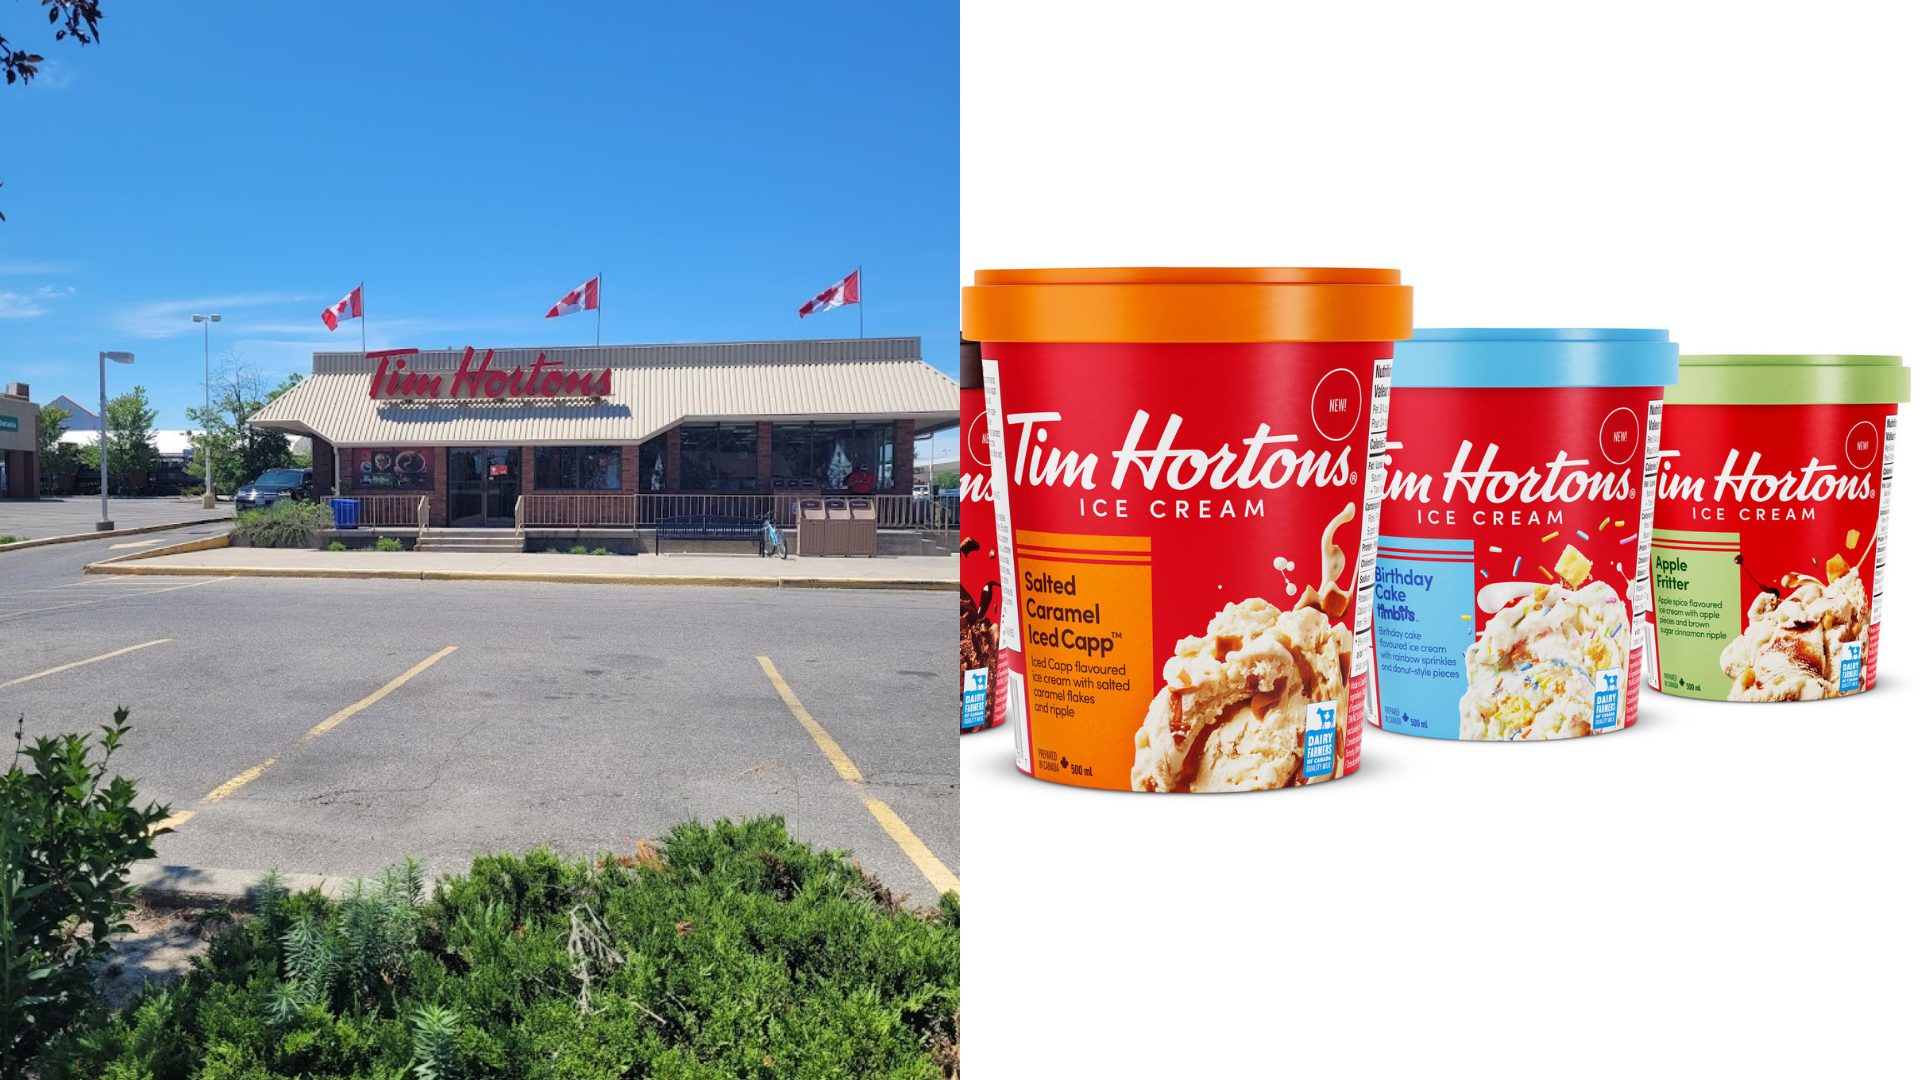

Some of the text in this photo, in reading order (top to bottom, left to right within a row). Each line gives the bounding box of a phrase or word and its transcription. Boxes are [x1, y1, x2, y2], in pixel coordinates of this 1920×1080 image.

[366, 346, 612, 399] Tim Hortons
[1329, 399, 1347, 412] NEW!
[1614, 431, 1628, 442] NEW!
[1007, 411, 1097, 490] Tim
[1079, 498, 1265, 519] ICE CREAM
[1692, 507, 1816, 521] ICE CREAM
[1417, 510, 1564, 526] ICE CREAM
[1656, 556, 1688, 574] Apple
[1025, 571, 1076, 596] Salted
[1375, 566, 1434, 591] Birthday
[1656, 574, 1690, 590] Fritter
[1375, 584, 1406, 602] Cake
[1026, 598, 1100, 624] Caramel
[1673, 598, 1688, 607] spice
[1690, 599, 1722, 608] flavoured
[1666, 608, 1684, 616] cream
[1700, 612, 1720, 620] apple
[1688, 620, 1710, 628] brown
[1028, 624, 1059, 648] Iced
[1378, 626, 1422, 640] Birthday cake
[1674, 628, 1705, 638] cinnamon
[1707, 631, 1727, 640] ripple
[1380, 638, 1447, 654] flavoured ice cream
[1032, 656, 1126, 676] Iced Capp flavoured
[1392, 654, 1420, 664] rainbow
[1422, 656, 1456, 666] sprinkles
[1382, 663, 1460, 679] and donut-style pieces
[1032, 670, 1130, 691] ice cream with salted
[966, 692, 985, 704] DAIRY
[1034, 688, 1096, 704] caramel flakes
[1597, 693, 1616, 705] DAIRY
[1035, 702, 1075, 719] and ripple
[1308, 732, 1333, 747] DAIRY
[1308, 744, 1332, 758] FARMERS
[1071, 764, 1082, 776] 500
